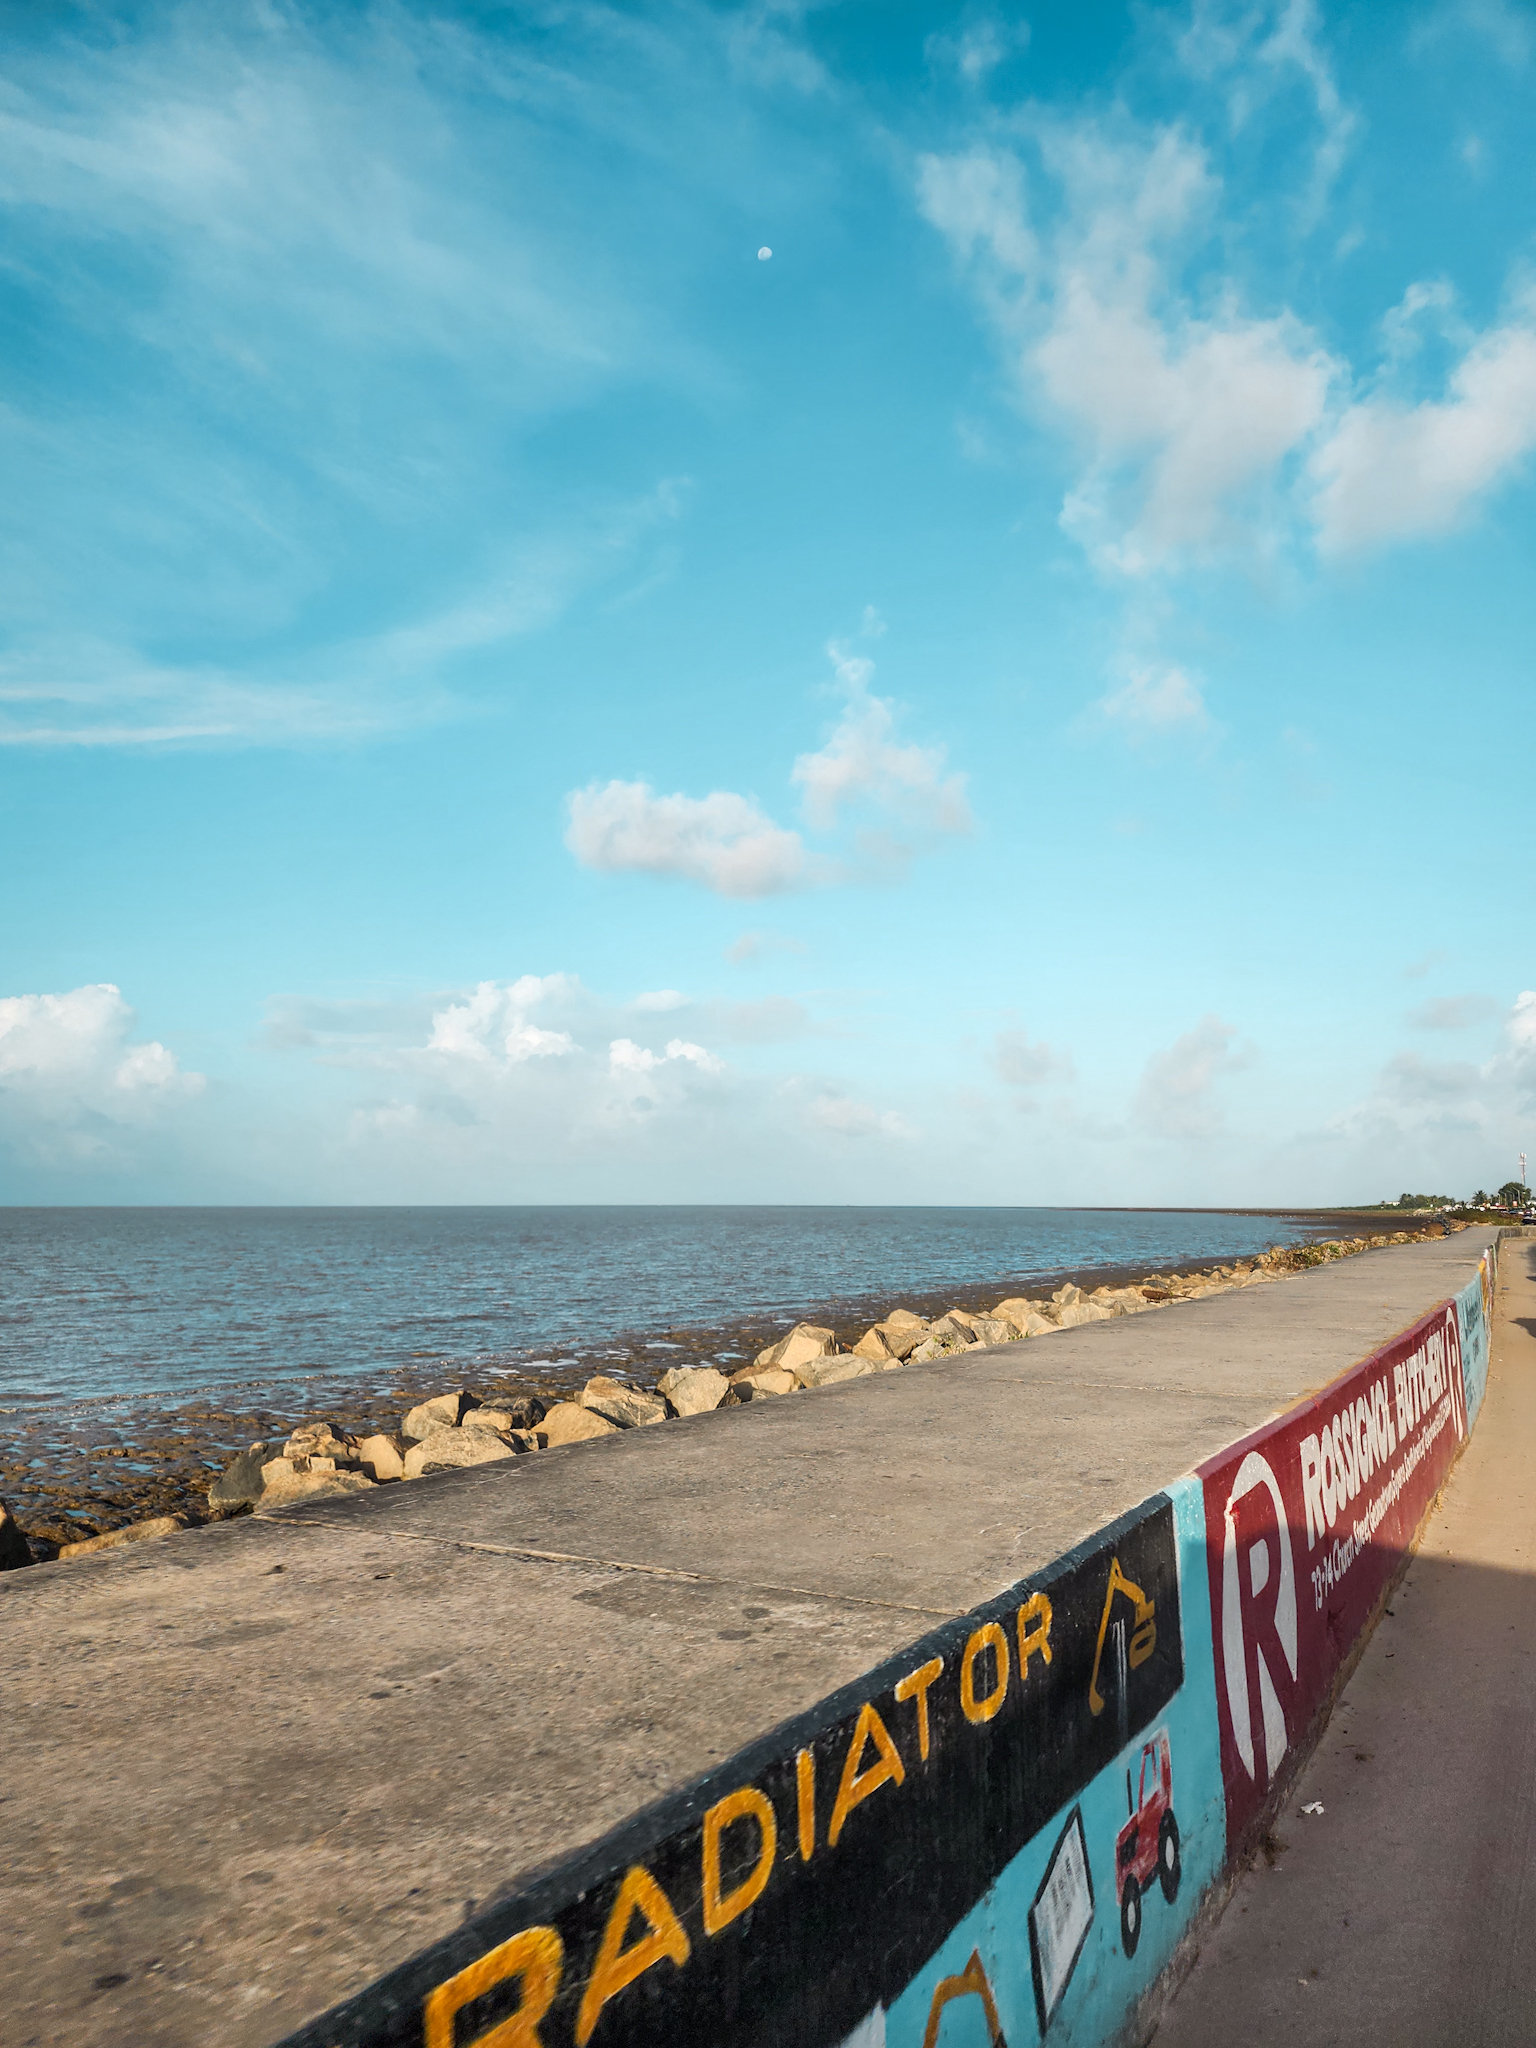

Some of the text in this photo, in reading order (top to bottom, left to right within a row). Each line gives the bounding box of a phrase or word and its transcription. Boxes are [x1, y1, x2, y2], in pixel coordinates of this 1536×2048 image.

[1299, 1375, 1397, 1551] ROSSIGNOL
[1393, 1326, 1448, 1442] BUTCHERY
[424, 1592, 1053, 2048] RADIATOR
